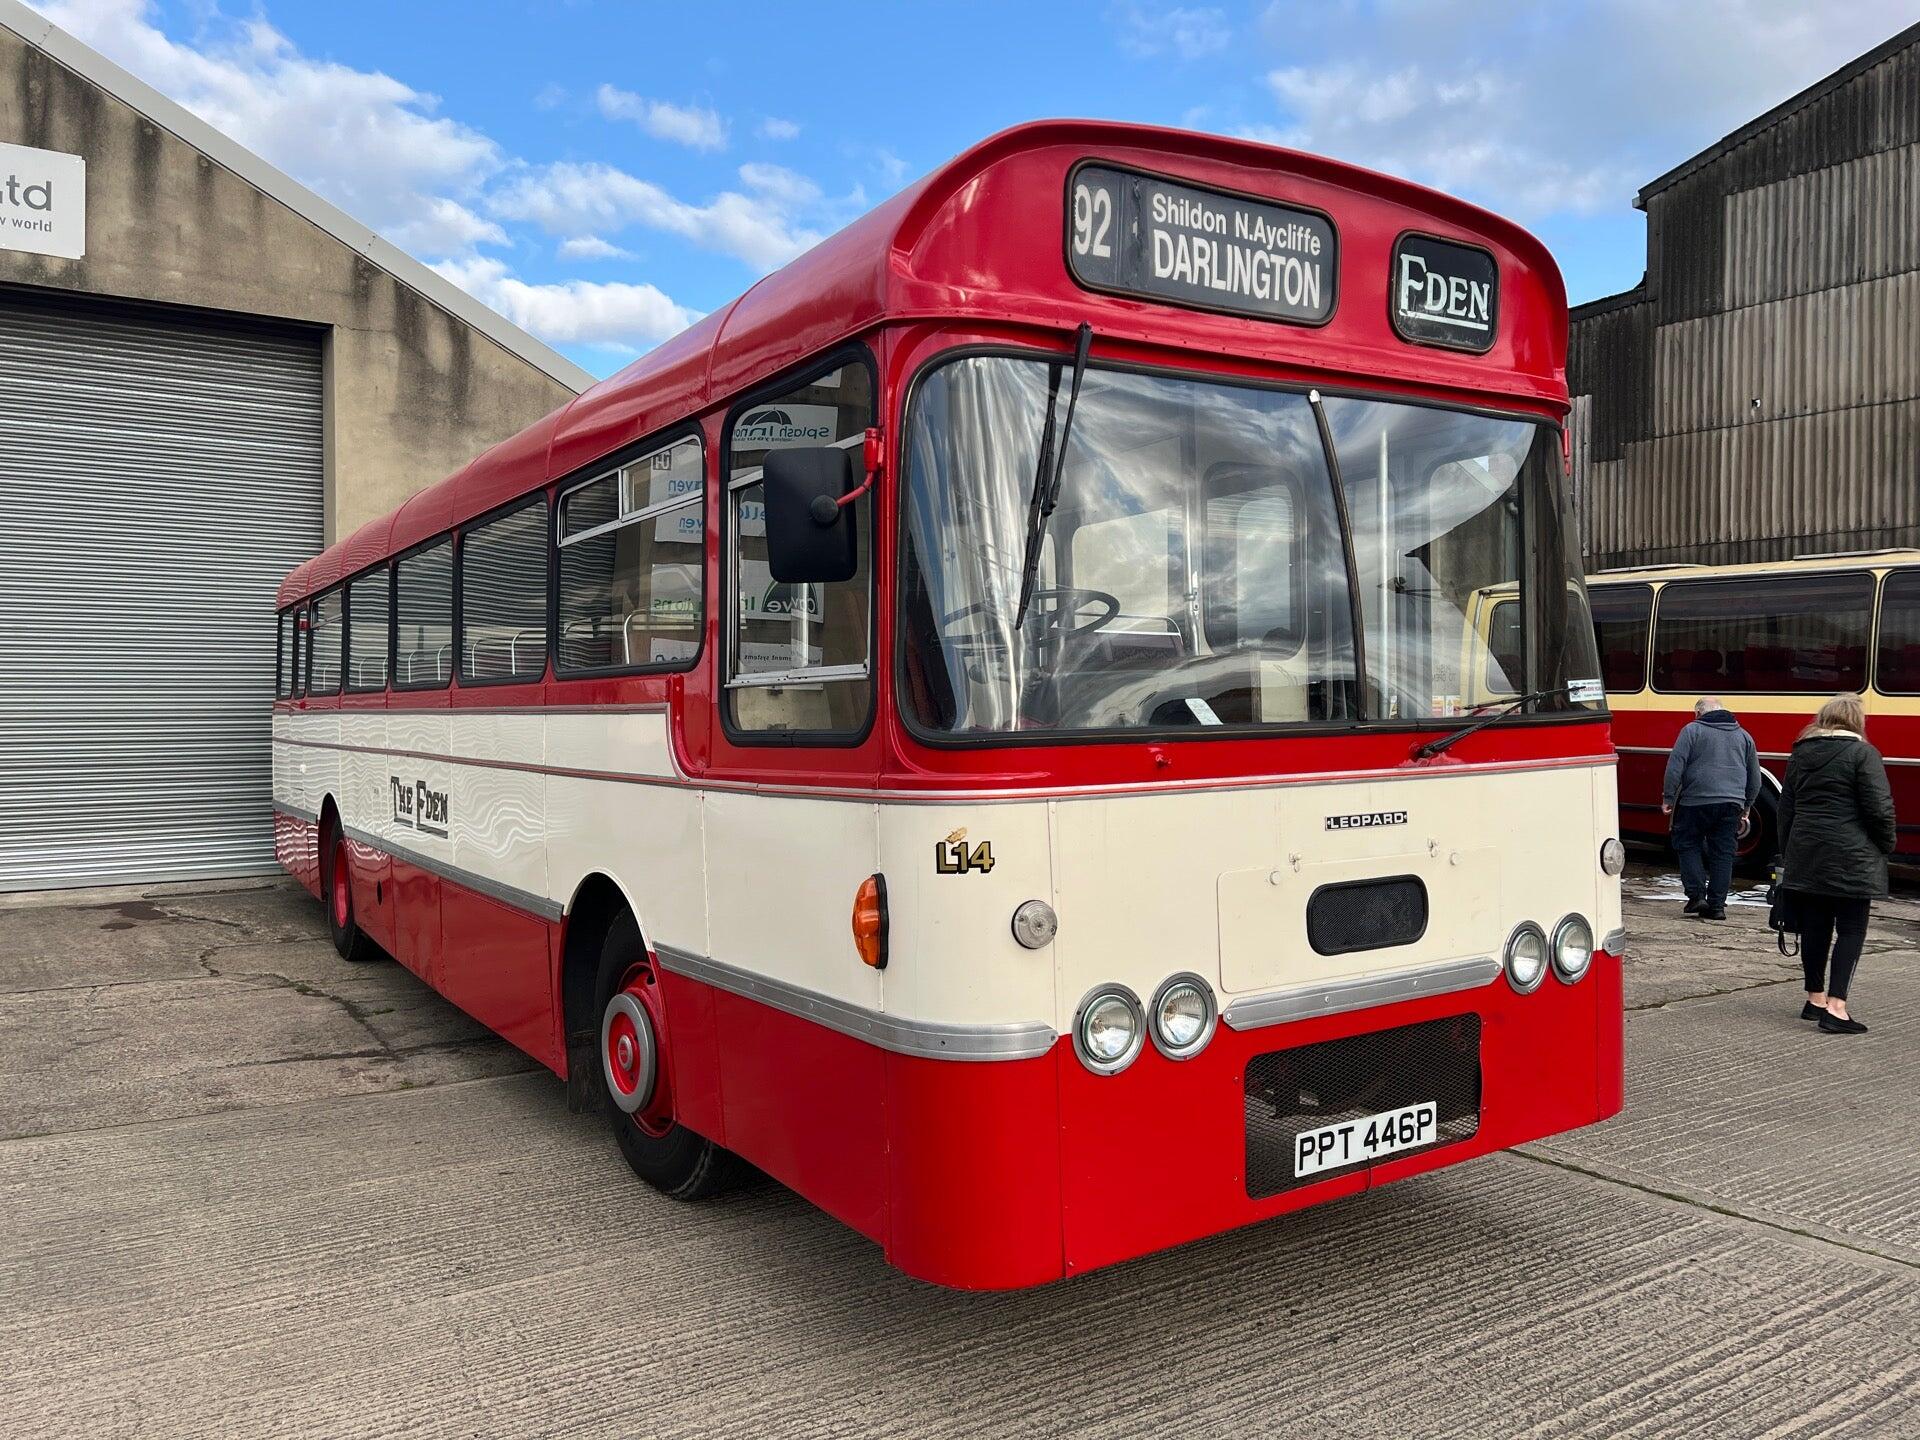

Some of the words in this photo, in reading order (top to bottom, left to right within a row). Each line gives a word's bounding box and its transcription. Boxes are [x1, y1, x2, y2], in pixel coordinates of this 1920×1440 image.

[0, 174, 52, 211] td
[12, 218, 52, 232] world
[1074, 184, 1112, 258] 92
[1152, 193, 1227, 235] Shildon
[1235, 211, 1321, 256] N.Aycliffe
[1153, 229, 1320, 309] DARLINGTON
[390, 775, 413, 822] THE
[1330, 813, 1404, 829] LEOPARD
[936, 841, 995, 874] L14
[1299, 1126, 1355, 1171] PPT
[1363, 1108, 1433, 1153] 446P
